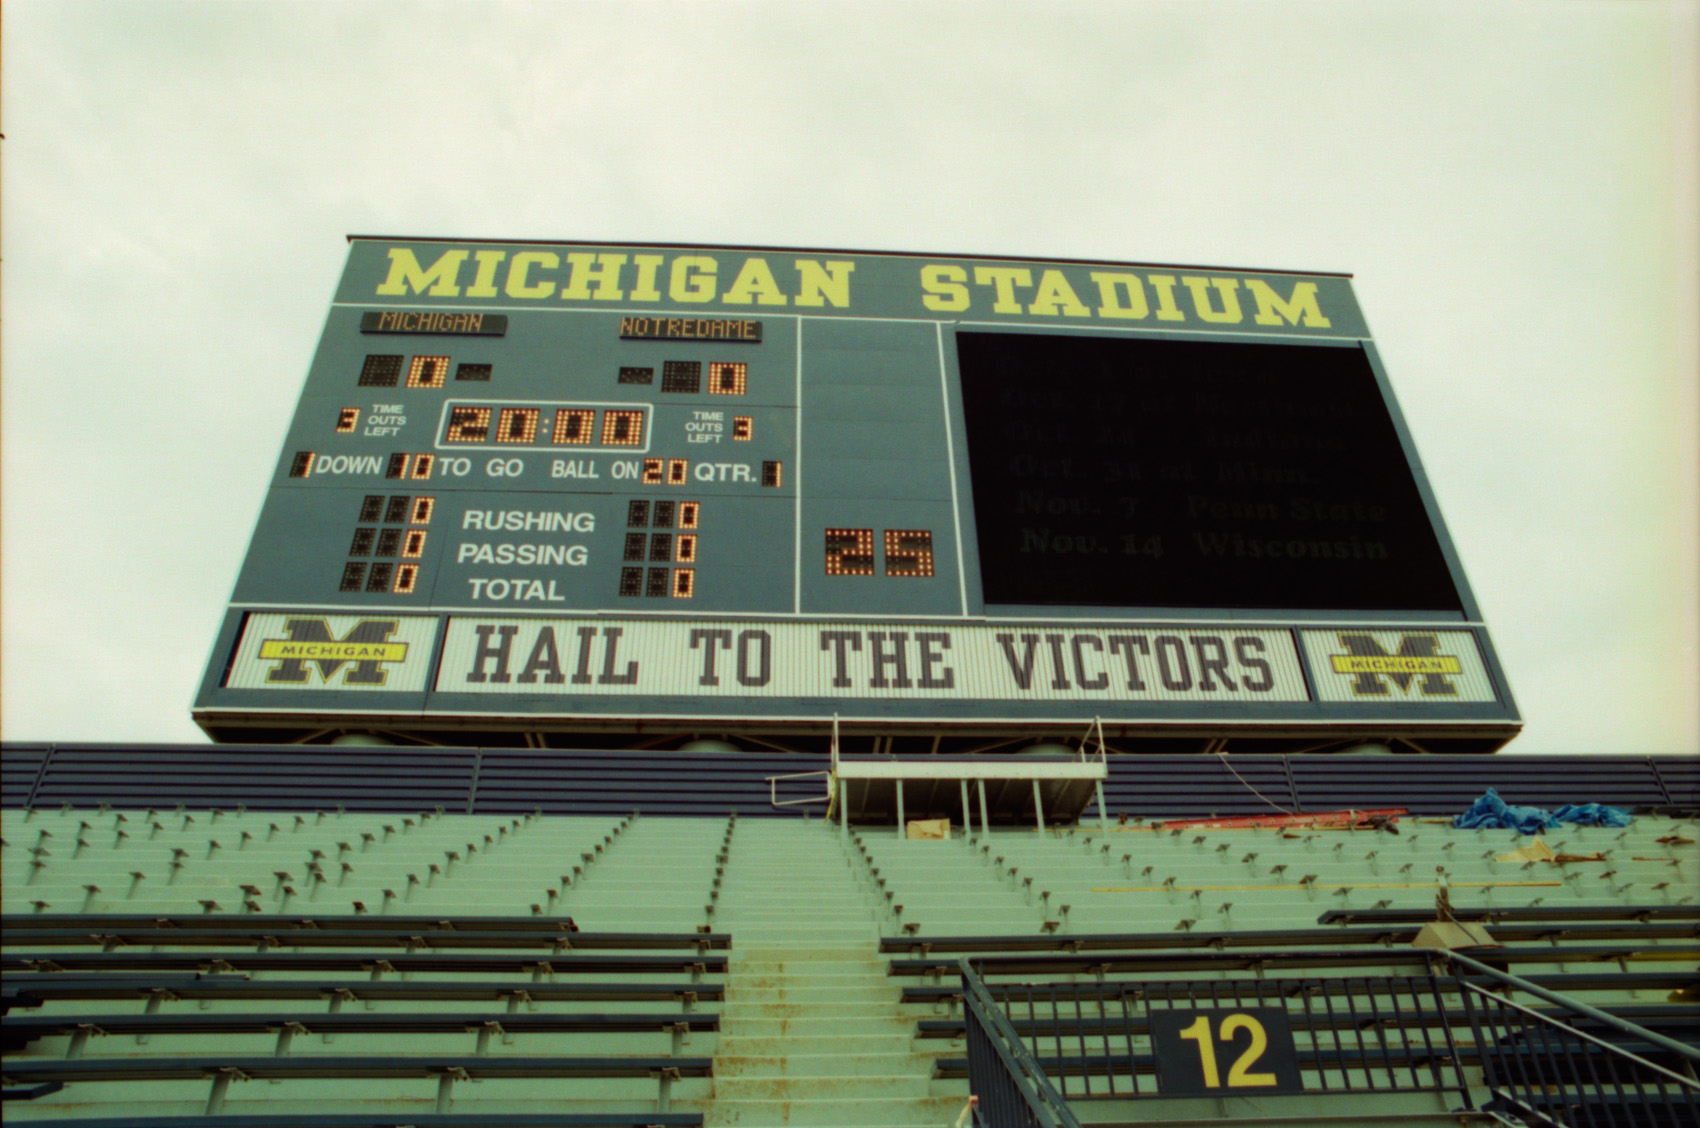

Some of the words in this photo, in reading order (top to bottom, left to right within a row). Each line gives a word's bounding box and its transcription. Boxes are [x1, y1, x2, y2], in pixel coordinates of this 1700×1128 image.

[376, 247, 855, 308] MICHIGAN
[919, 264, 1332, 328] STADIUM
[378, 312, 484, 332] MICHIGAN
[405, 355, 450, 388] 0
[708, 362, 748, 395] 0
[335, 407, 361, 433] 3
[368, 415, 407, 426] OUTS
[372, 404, 404, 414] TIME
[692, 411, 724, 421] TIME
[364, 427, 400, 437] LEFT
[447, 407, 644, 445] 20:00
[685, 422, 723, 433] OUTS
[687, 433, 722, 444] LEFT
[733, 416, 753, 441] 3
[315, 455, 383, 475] DOWN
[398, 453, 436, 479] 10
[439, 457, 472, 476] TO
[486, 458, 524, 477] GO
[551, 460, 599, 478] BALL
[611, 460, 639, 479] ON
[642, 458, 689, 485] 20
[694, 463, 757, 482] QTR.
[410, 497, 435, 525] 0
[678, 501, 700, 529] 0
[1015, 489, 1102, 517] Nov.
[1186, 493, 1280, 521] Penn
[1289, 496, 1388, 523] State
[462, 510, 596, 533] RUSHING
[402, 529, 428, 558] 0
[457, 543, 589, 566] PASSING
[675, 533, 698, 563] 0
[825, 528, 934, 577] 25
[1020, 527, 1109, 555] Nov.
[1121, 532, 1165, 559] 14
[1190, 532, 1389, 560] Wisconsin
[393, 563, 420, 593] 0
[468, 578, 566, 601] TOTAL
[672, 567, 695, 598] 0
[281, 645, 387, 657] MICHIGAN
[466, 624, 639, 685] HAIL
[690, 628, 771, 687] TO
[820, 630, 955, 689] THE
[996, 633, 1275, 693] VICTORS
[1351, 659, 1443, 671] MICHIGAN
[1179, 1013, 1277, 1088] 12
